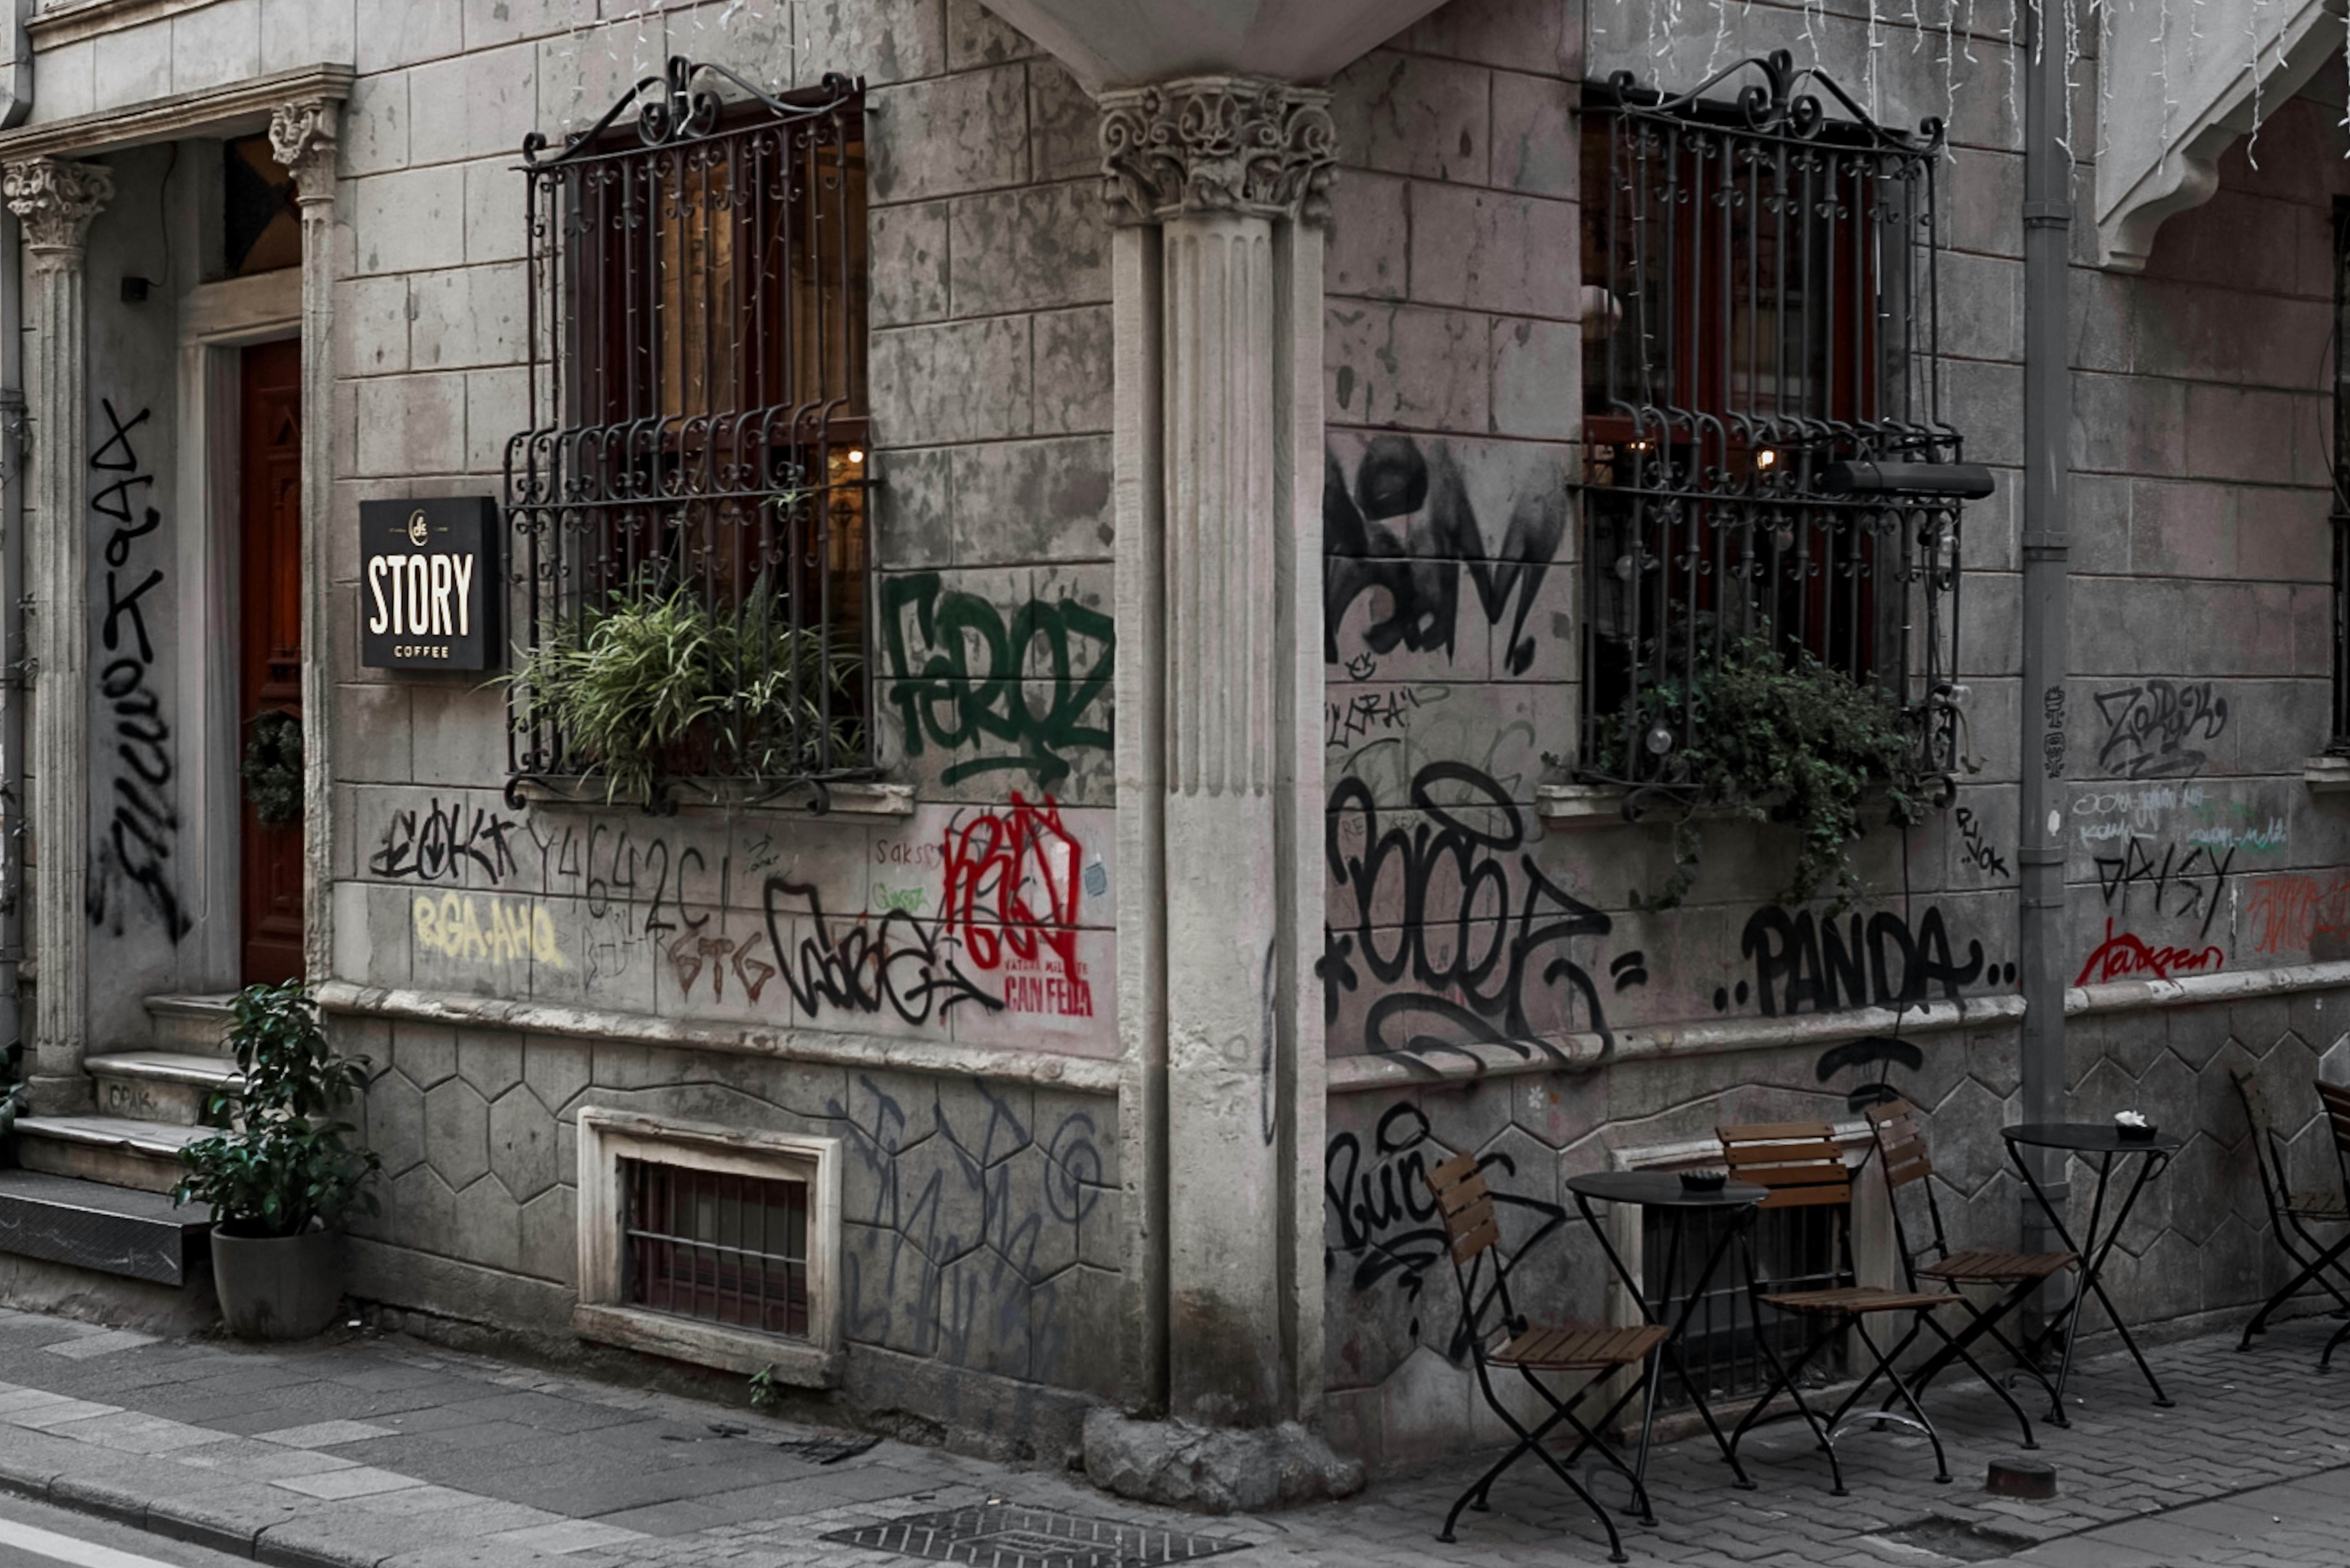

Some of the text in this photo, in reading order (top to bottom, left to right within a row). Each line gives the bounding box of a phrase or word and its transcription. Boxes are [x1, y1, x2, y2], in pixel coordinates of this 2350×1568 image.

[369, 553, 474, 636] STORY
[394, 645, 449, 658] COFFEE
[1005, 975, 1042, 1013] CAN
